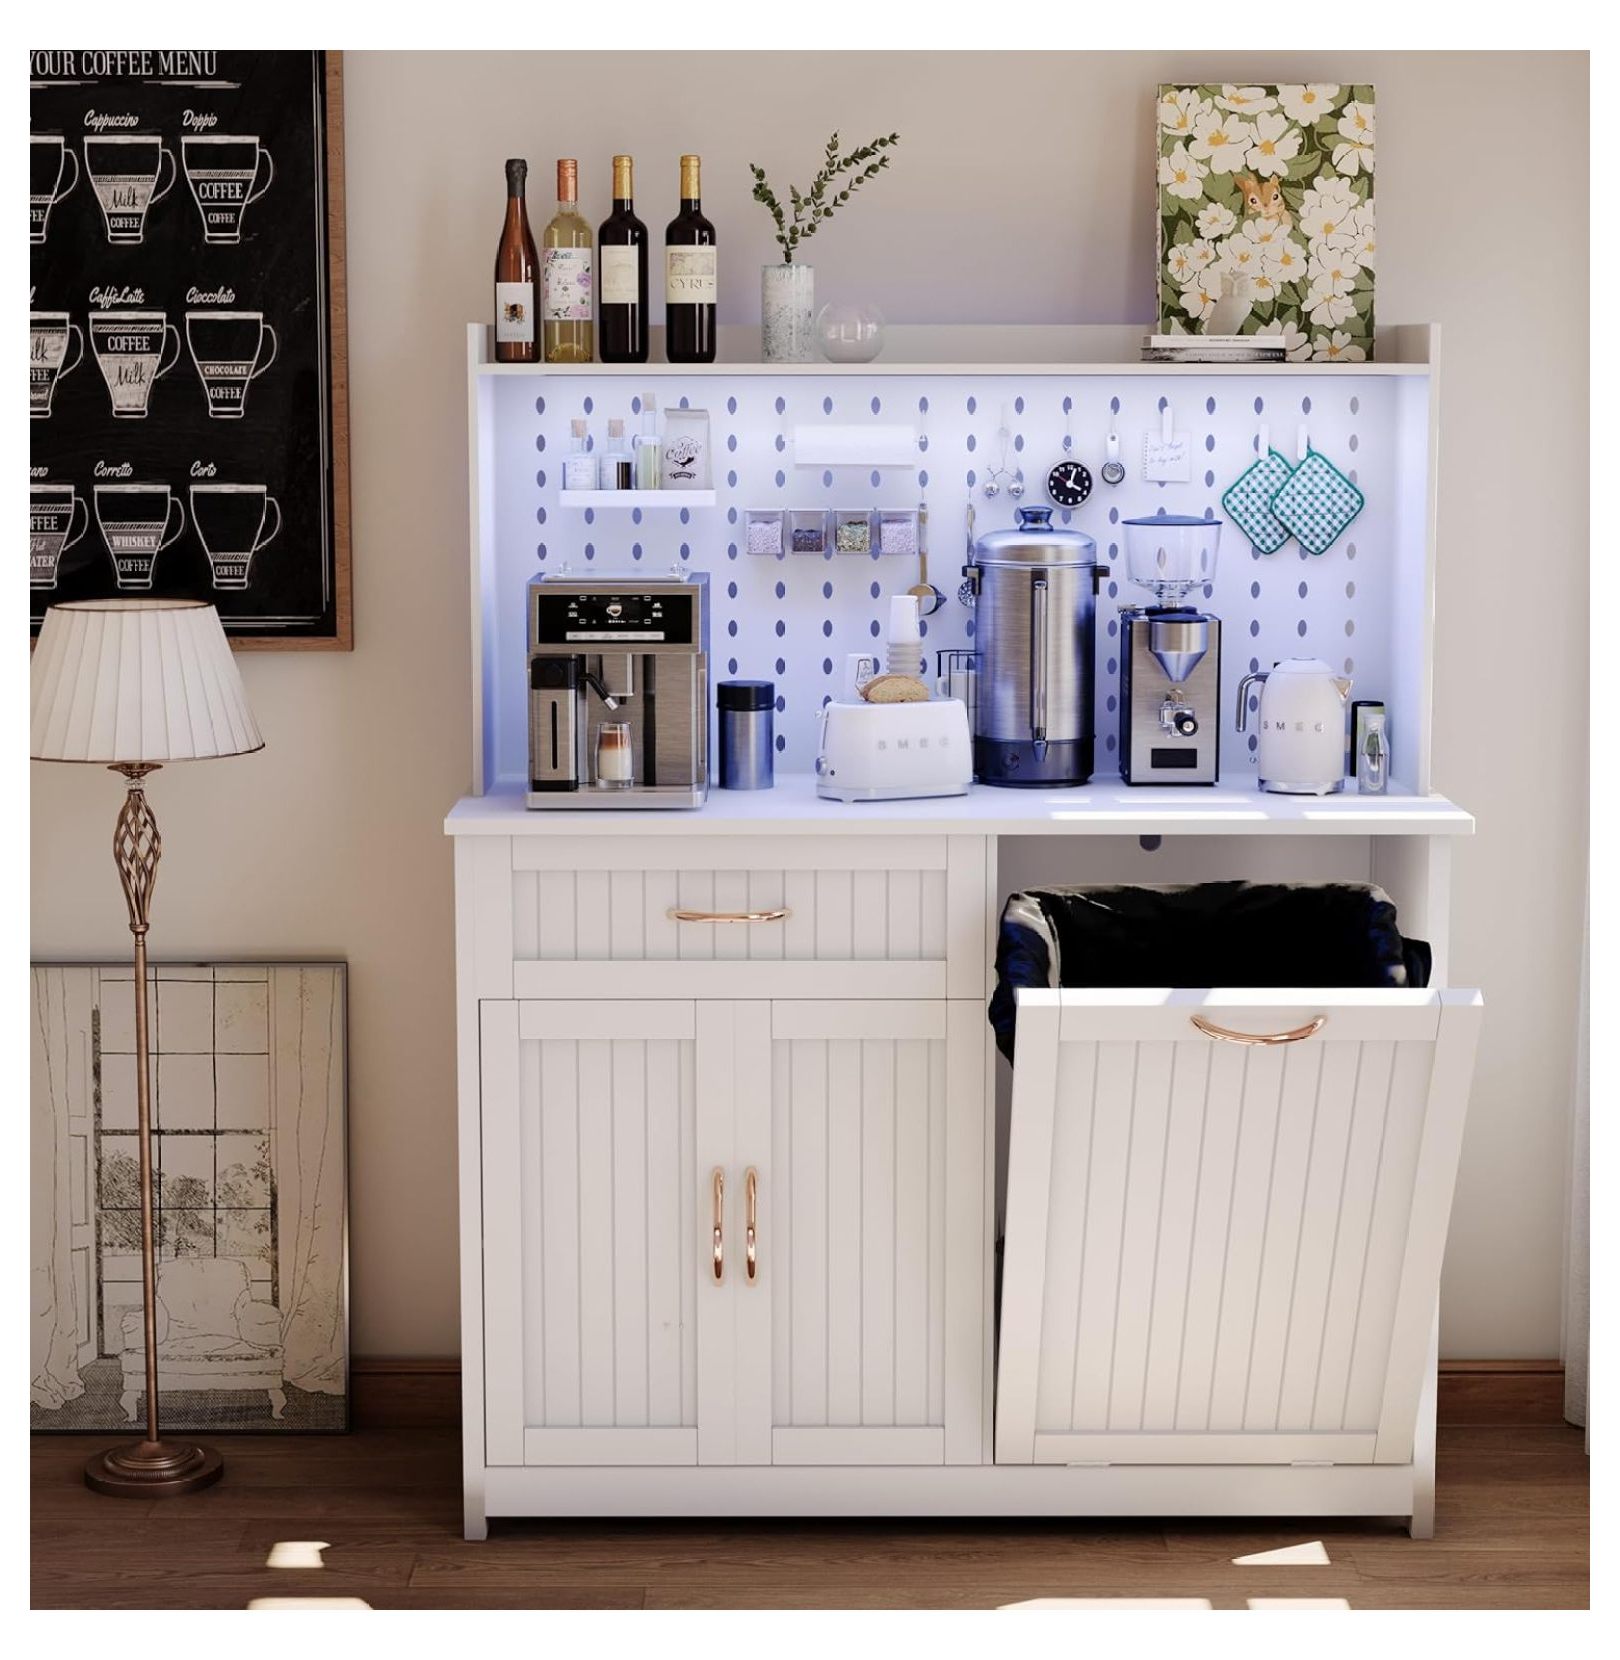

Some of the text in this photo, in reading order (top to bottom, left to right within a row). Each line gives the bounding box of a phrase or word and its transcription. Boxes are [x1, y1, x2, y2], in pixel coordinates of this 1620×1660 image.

[82, 51, 153, 76] COFFEE
[158, 51, 217, 76] MENU
[83, 109, 139, 132] Cappuccino
[182, 109, 218, 132] Doppio
[109, 186, 138, 209] Milk
[199, 182, 243, 199] COFFEE
[110, 217, 140, 228] COFFEE
[208, 213, 236, 224] COFFEE
[186, 286, 236, 304] Cioccolato
[107, 336, 150, 351] COFFEE
[114, 362, 146, 387] Milk
[210, 387, 242, 399] COFFEE
[94, 460, 133, 477] Corretto
[190, 460, 217, 477] Corto
[112, 536, 156, 547] WHISKEY
[118, 559, 151, 572] COFFEE
[216, 565, 245, 576] COFFEE
